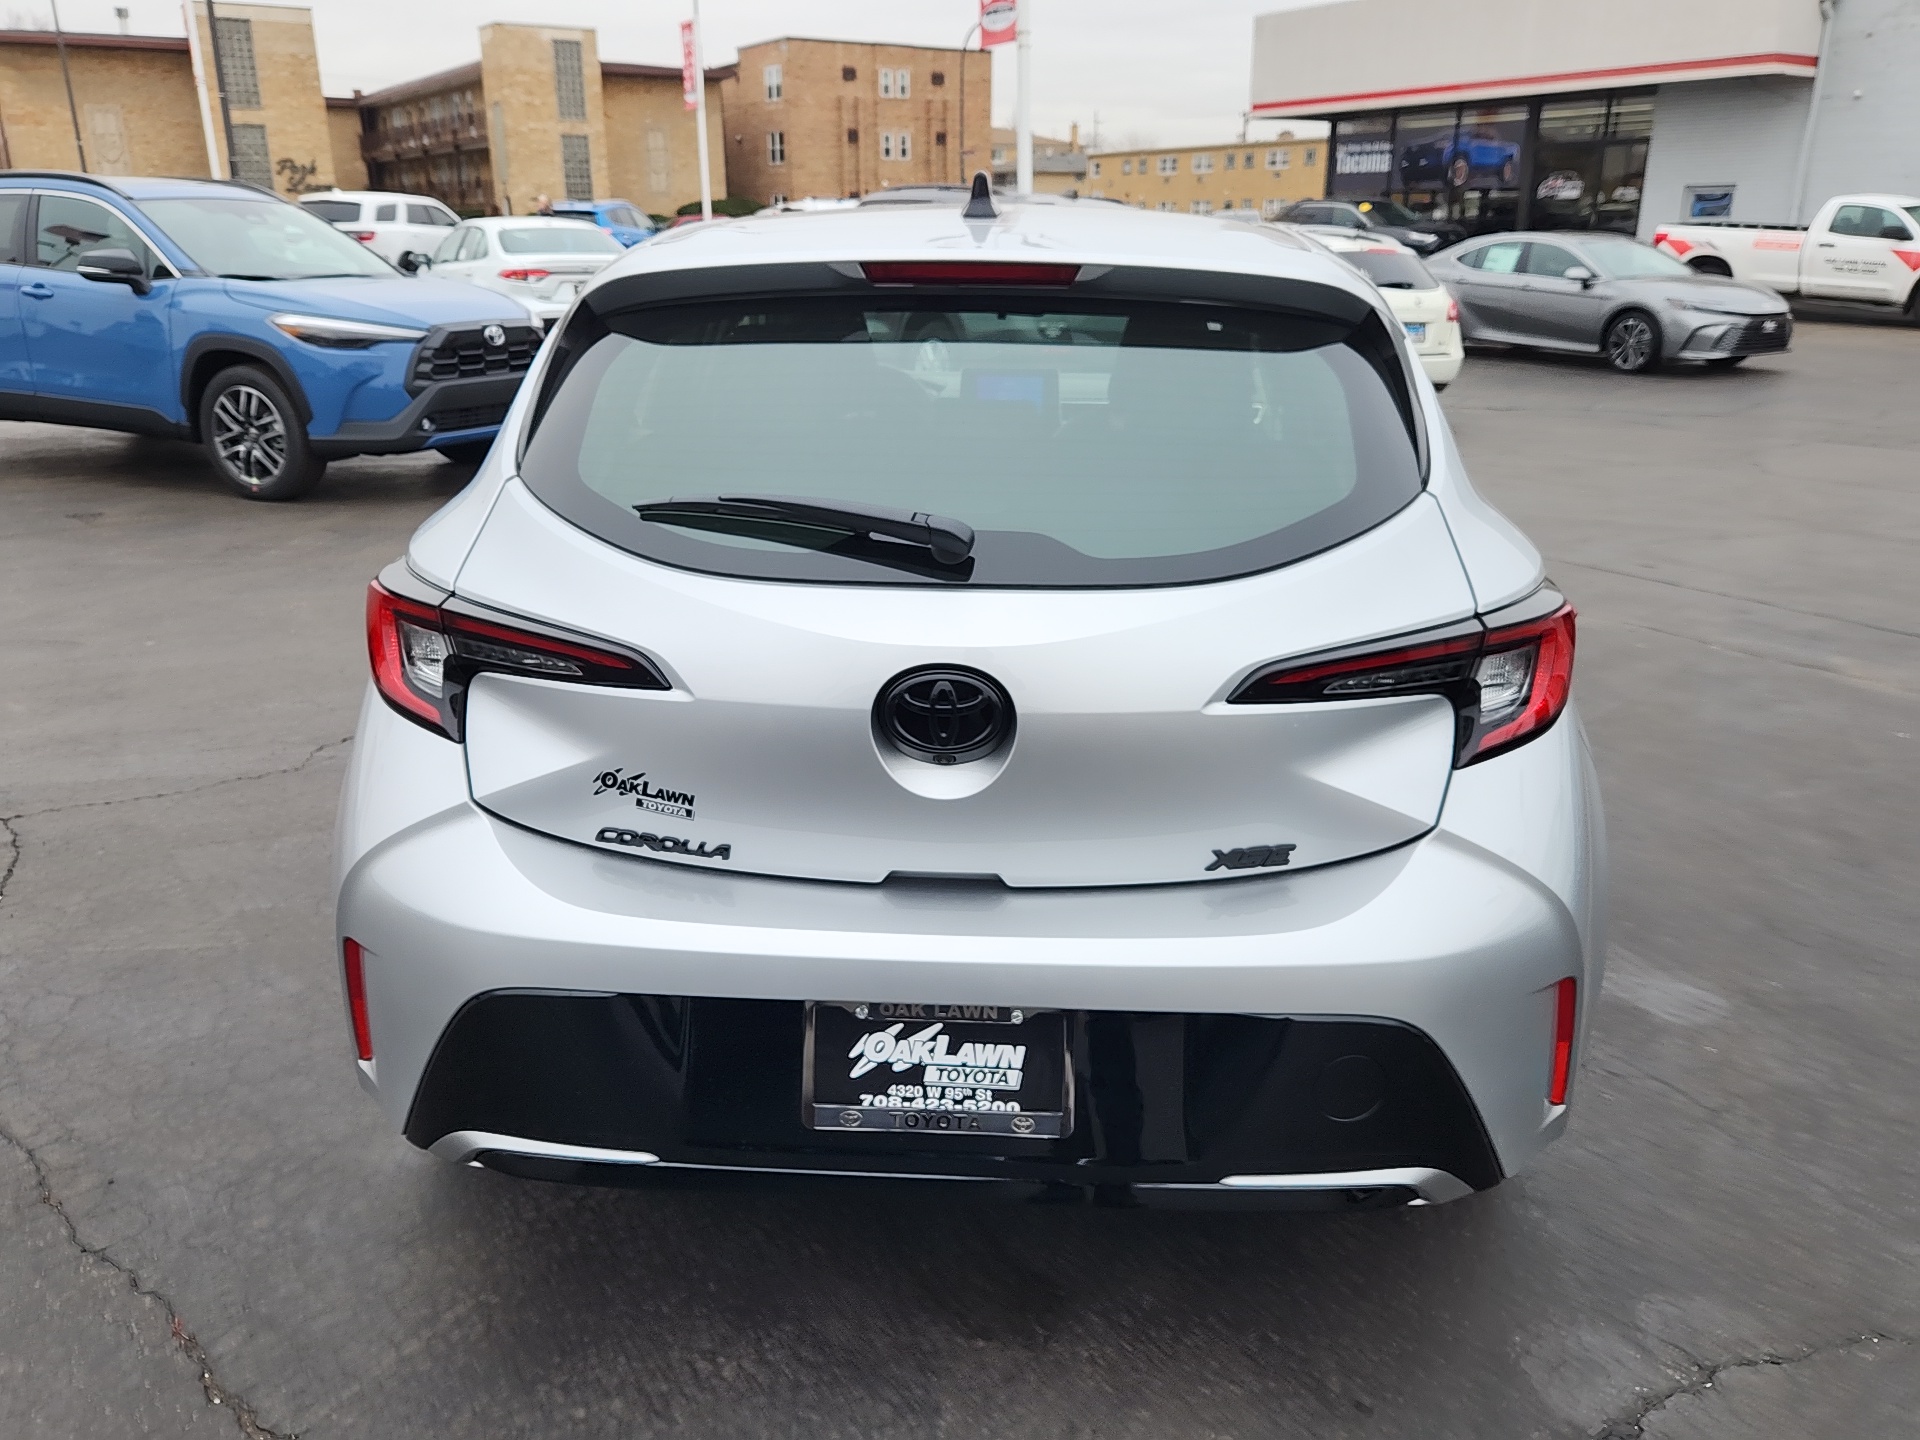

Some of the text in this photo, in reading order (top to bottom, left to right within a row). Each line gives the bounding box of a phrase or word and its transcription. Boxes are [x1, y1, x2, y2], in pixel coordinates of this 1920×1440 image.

[641, 799, 687, 817] TOYOTA
[594, 826, 732, 860] COROLLA
[1204, 843, 1297, 871] XSE
[879, 1003, 998, 1020] OAK LAWN
[936, 1067, 1010, 1085] TOYOTA
[886, 1084, 993, 1101] 4320 W 95th St
[888, 1111, 981, 1130] TOYOTA
